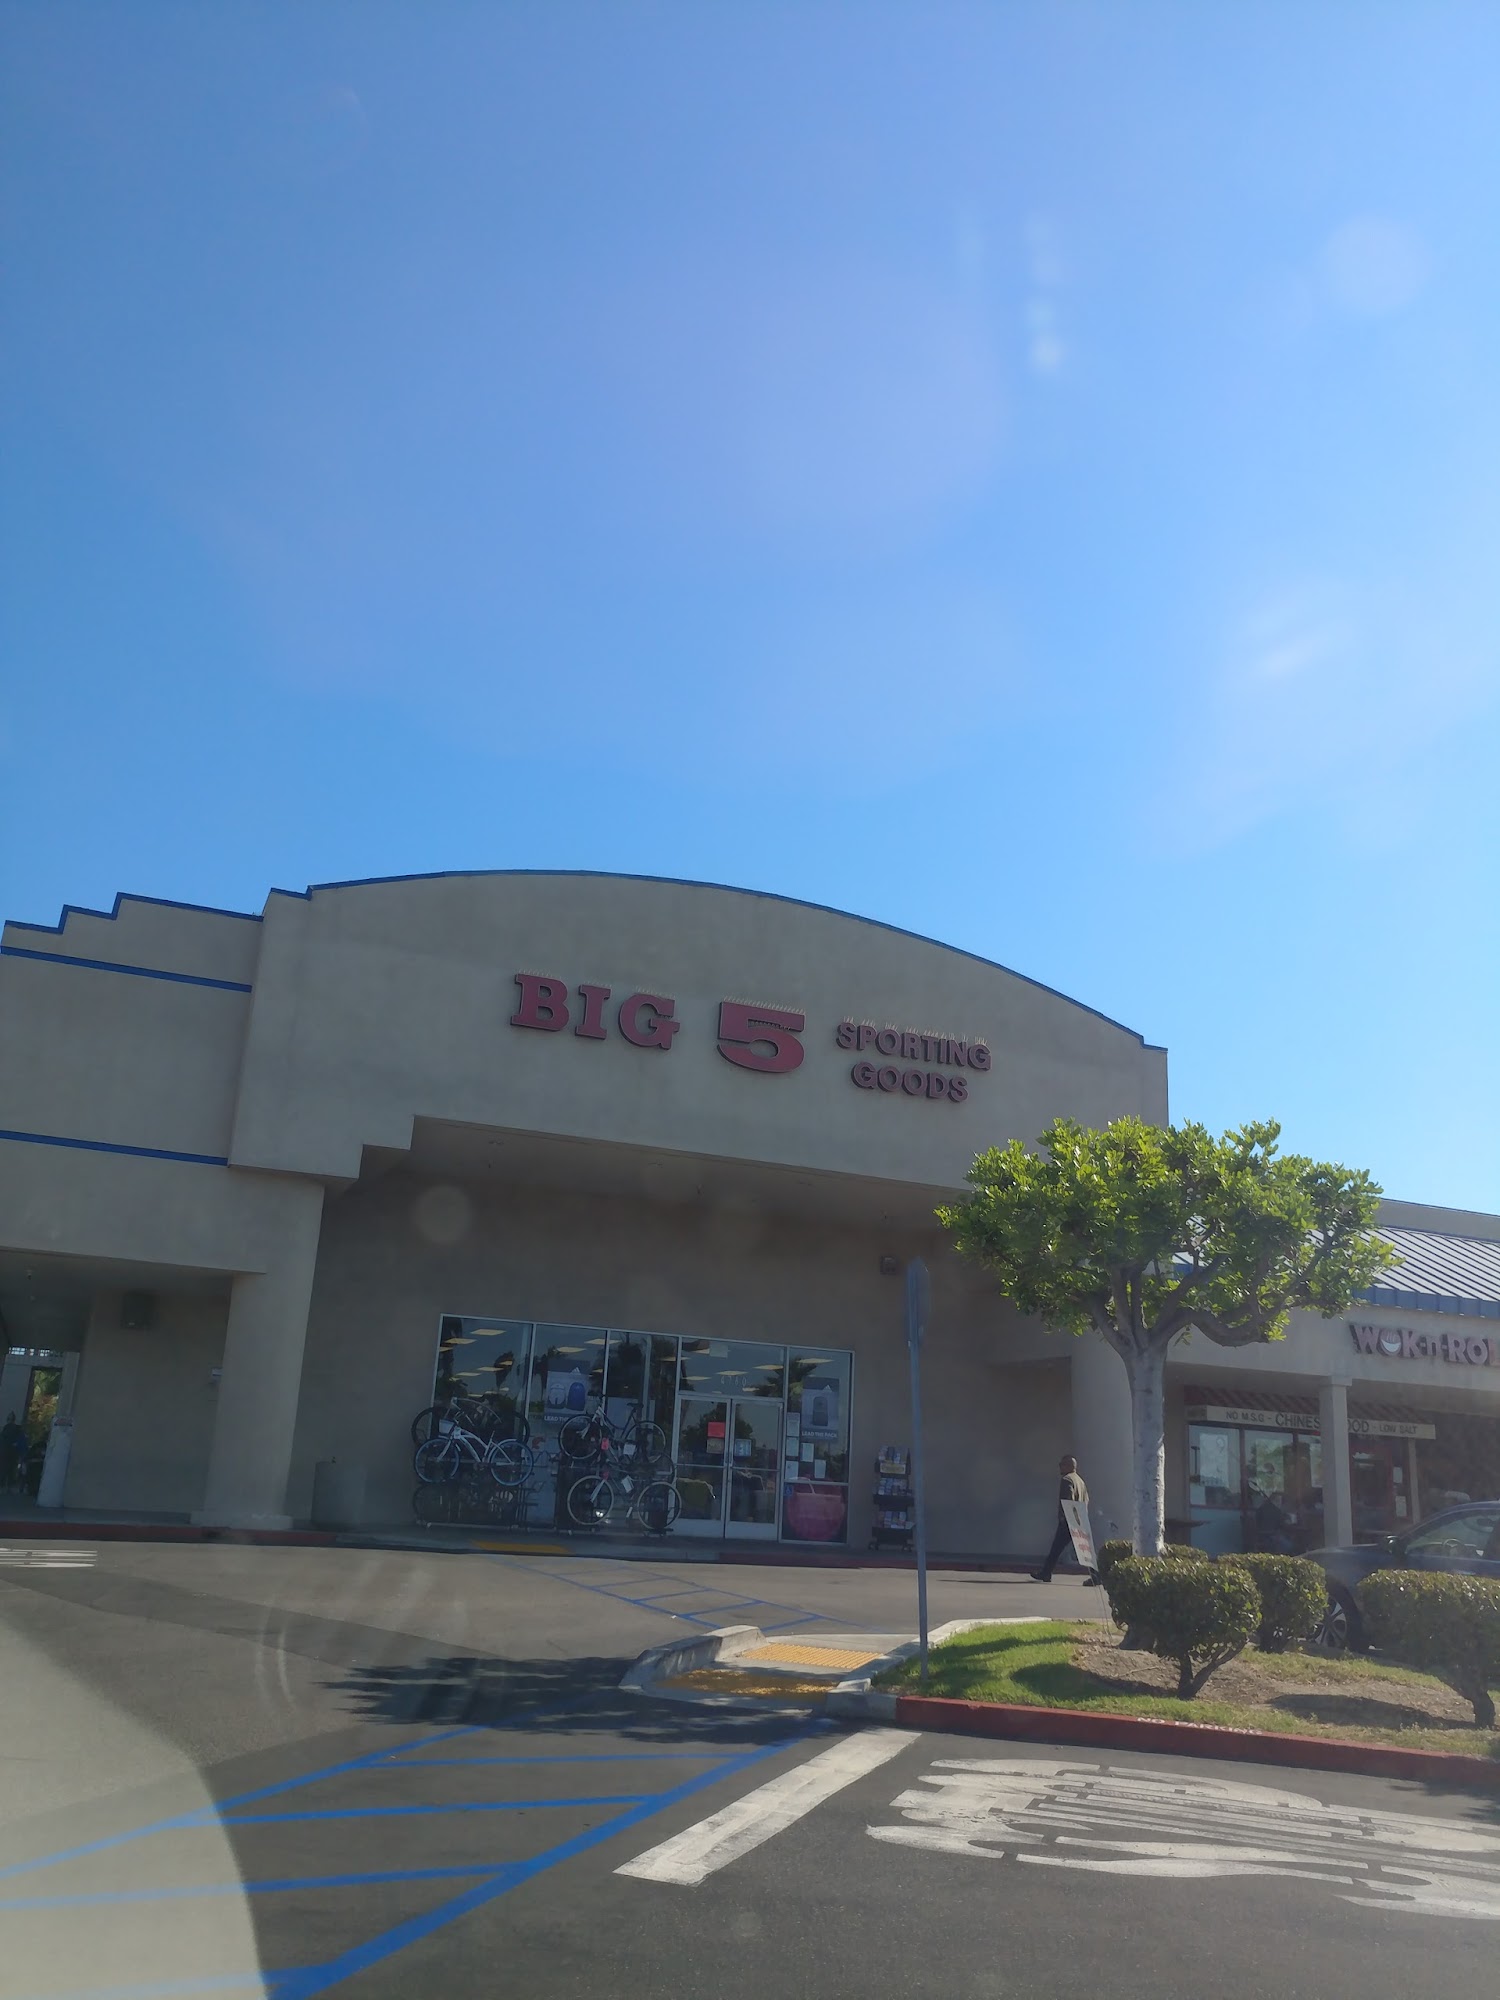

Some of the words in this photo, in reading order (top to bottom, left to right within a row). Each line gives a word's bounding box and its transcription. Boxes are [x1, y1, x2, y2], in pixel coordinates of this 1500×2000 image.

[510, 972, 681, 1050] BIG
[716, 998, 805, 1074] 5
[836, 1020, 992, 1072] SPORTING
[851, 1061, 969, 1103] GOODS
[1226, 1410, 1238, 1419] NO
[1275, 1413, 1320, 1429] CHINES
